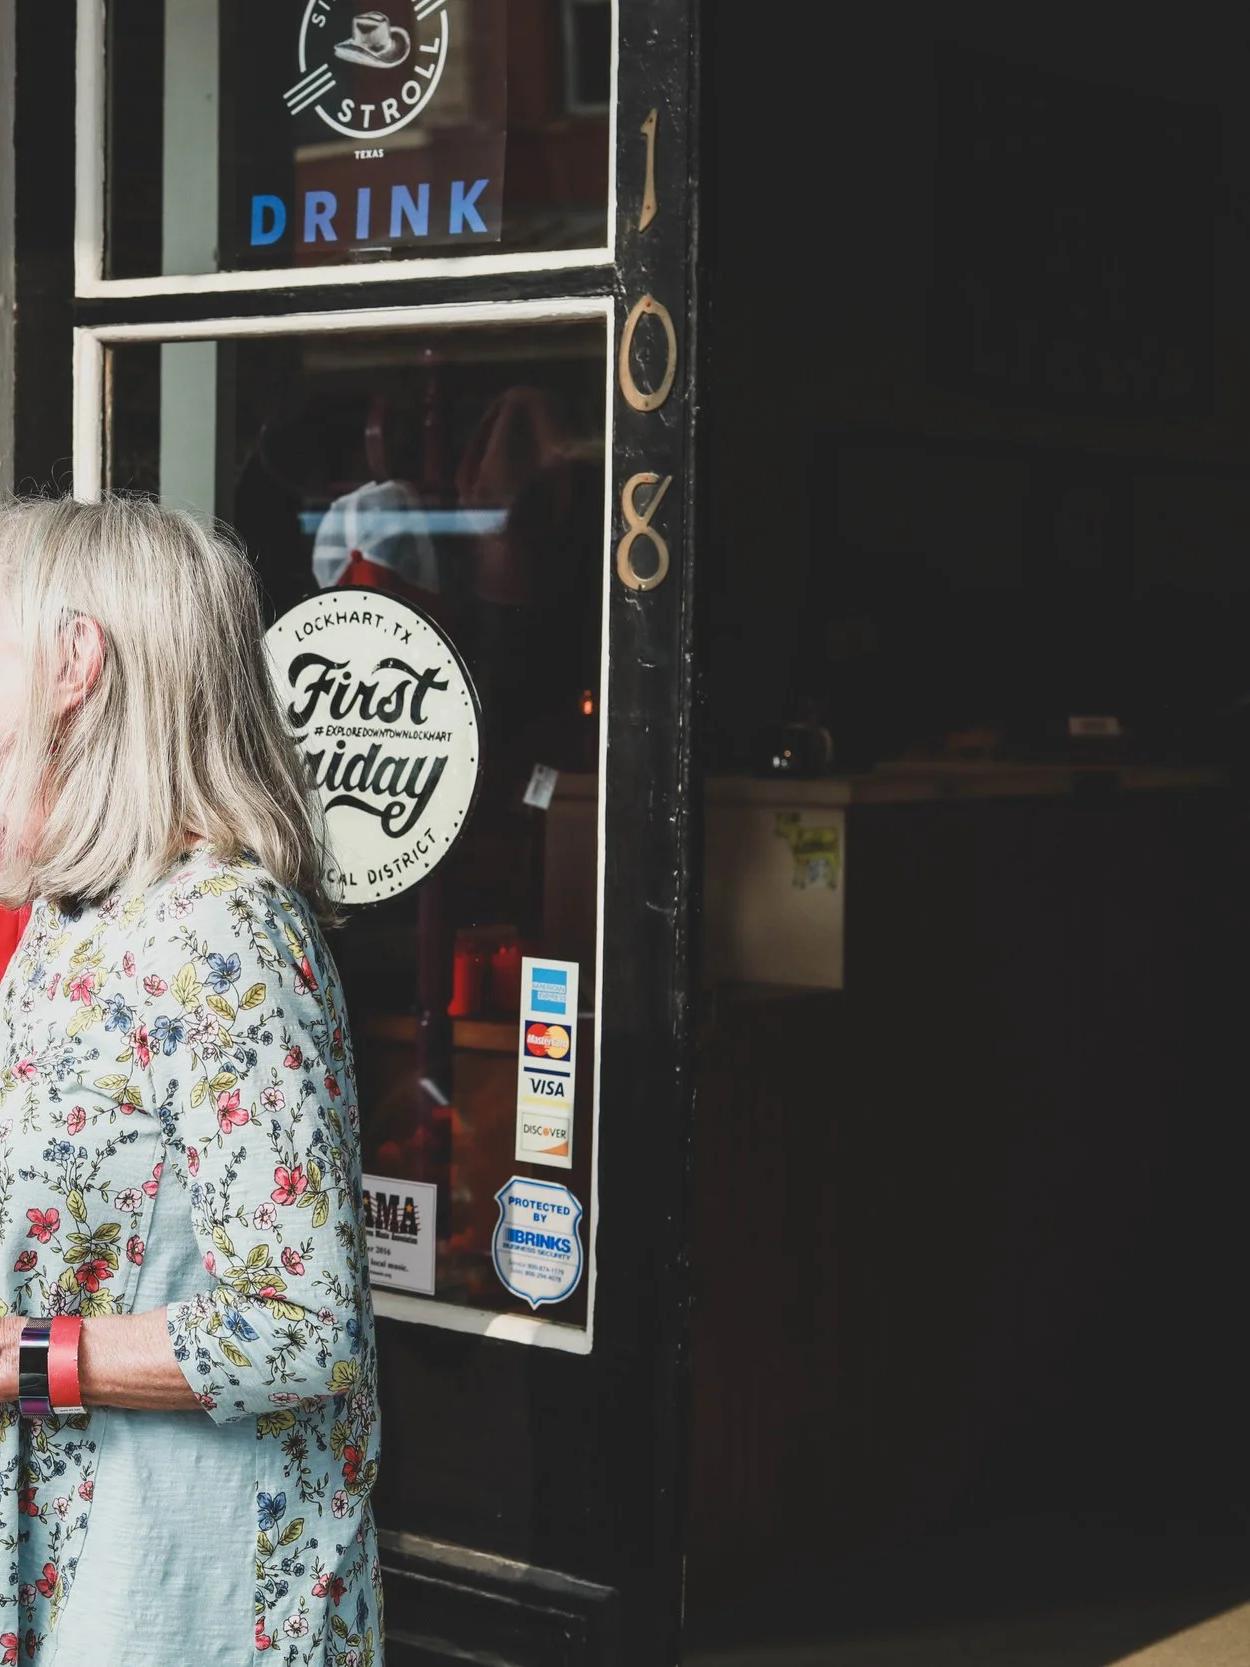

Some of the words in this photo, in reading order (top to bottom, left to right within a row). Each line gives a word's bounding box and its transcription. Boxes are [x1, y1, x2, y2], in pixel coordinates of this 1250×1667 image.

[337, 38, 440, 128] STROLL
[354, 148, 384, 159] TEXAS
[250, 179, 490, 246] DRINK
[392, 622, 413, 645] TX
[287, 652, 450, 728] First
[314, 725, 453, 742] #EXPLOREDOWNTOWNLOCKHART
[367, 827, 436, 885] DISTRICT
[530, 1078, 565, 1097] VISA
[523, 1123, 567, 1139] DISCOVER
[508, 1196, 570, 1216] PROTECTED
[533, 1212, 547, 1223] BY
[514, 1229, 571, 1254] BRINKS
